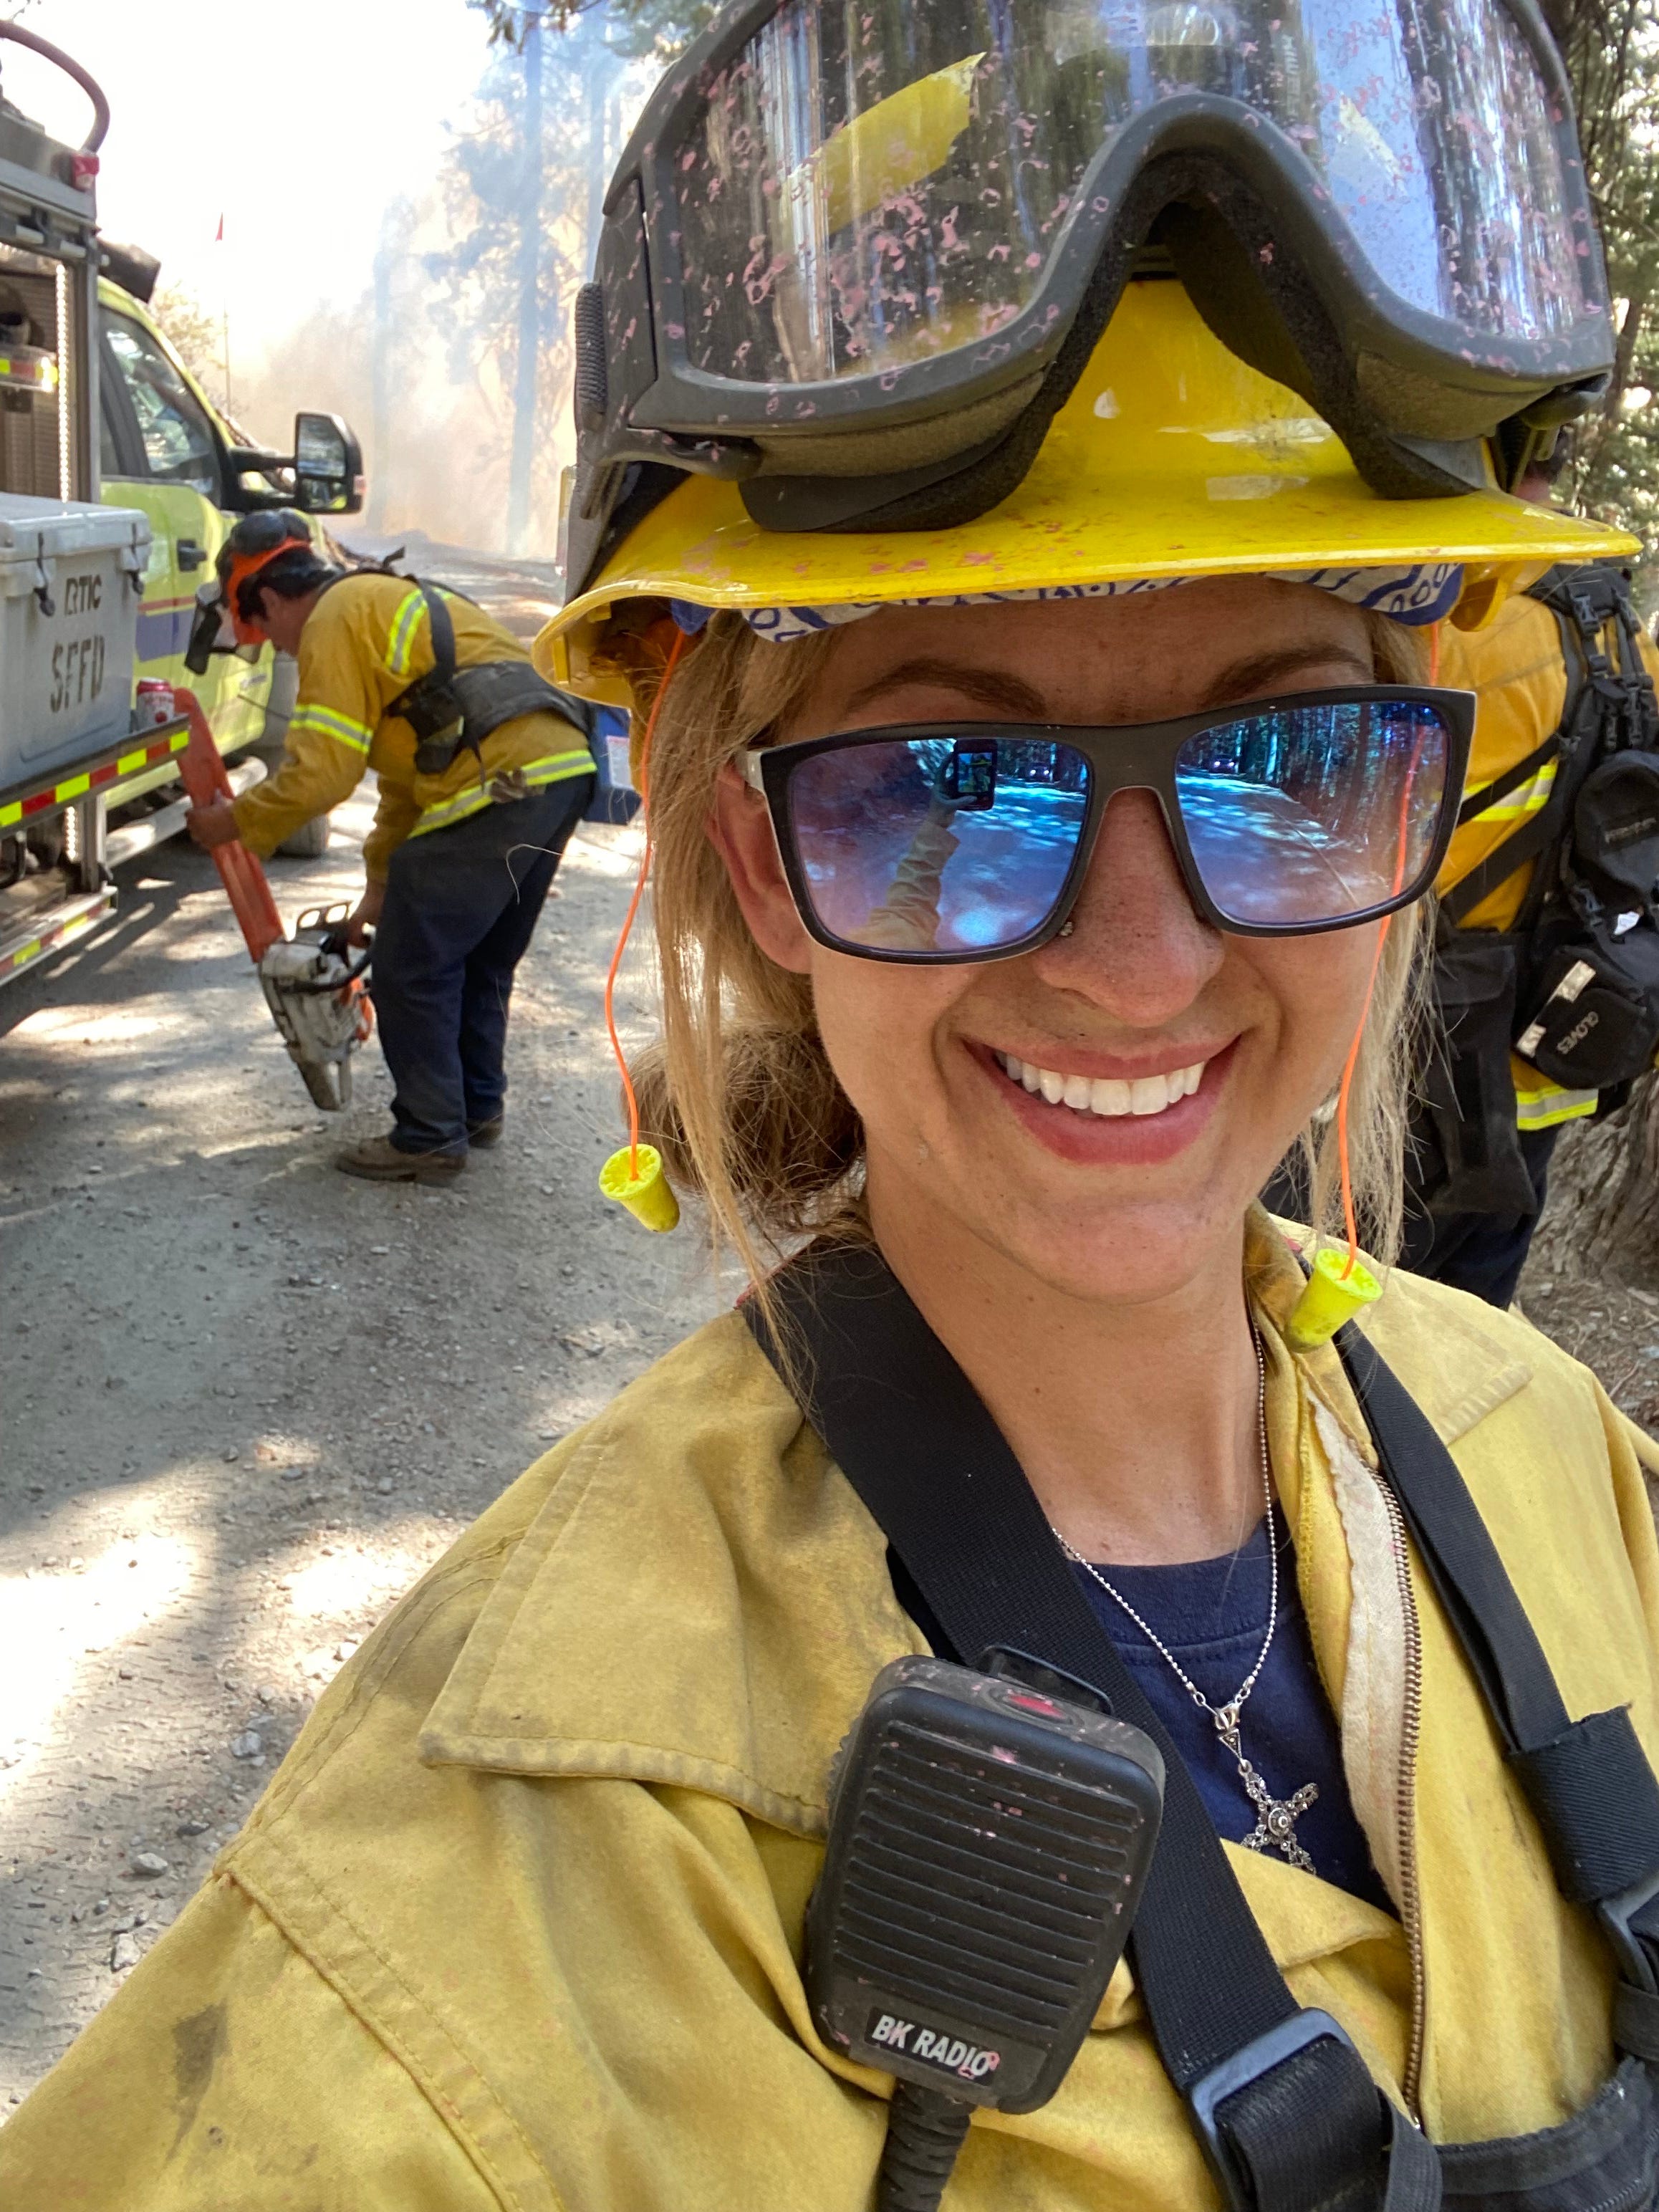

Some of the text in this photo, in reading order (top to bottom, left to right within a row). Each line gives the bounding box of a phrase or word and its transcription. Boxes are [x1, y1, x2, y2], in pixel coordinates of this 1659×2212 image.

[1557, 1011, 1600, 1055] GLOVES
[871, 2014, 993, 2077] BK RADIO
